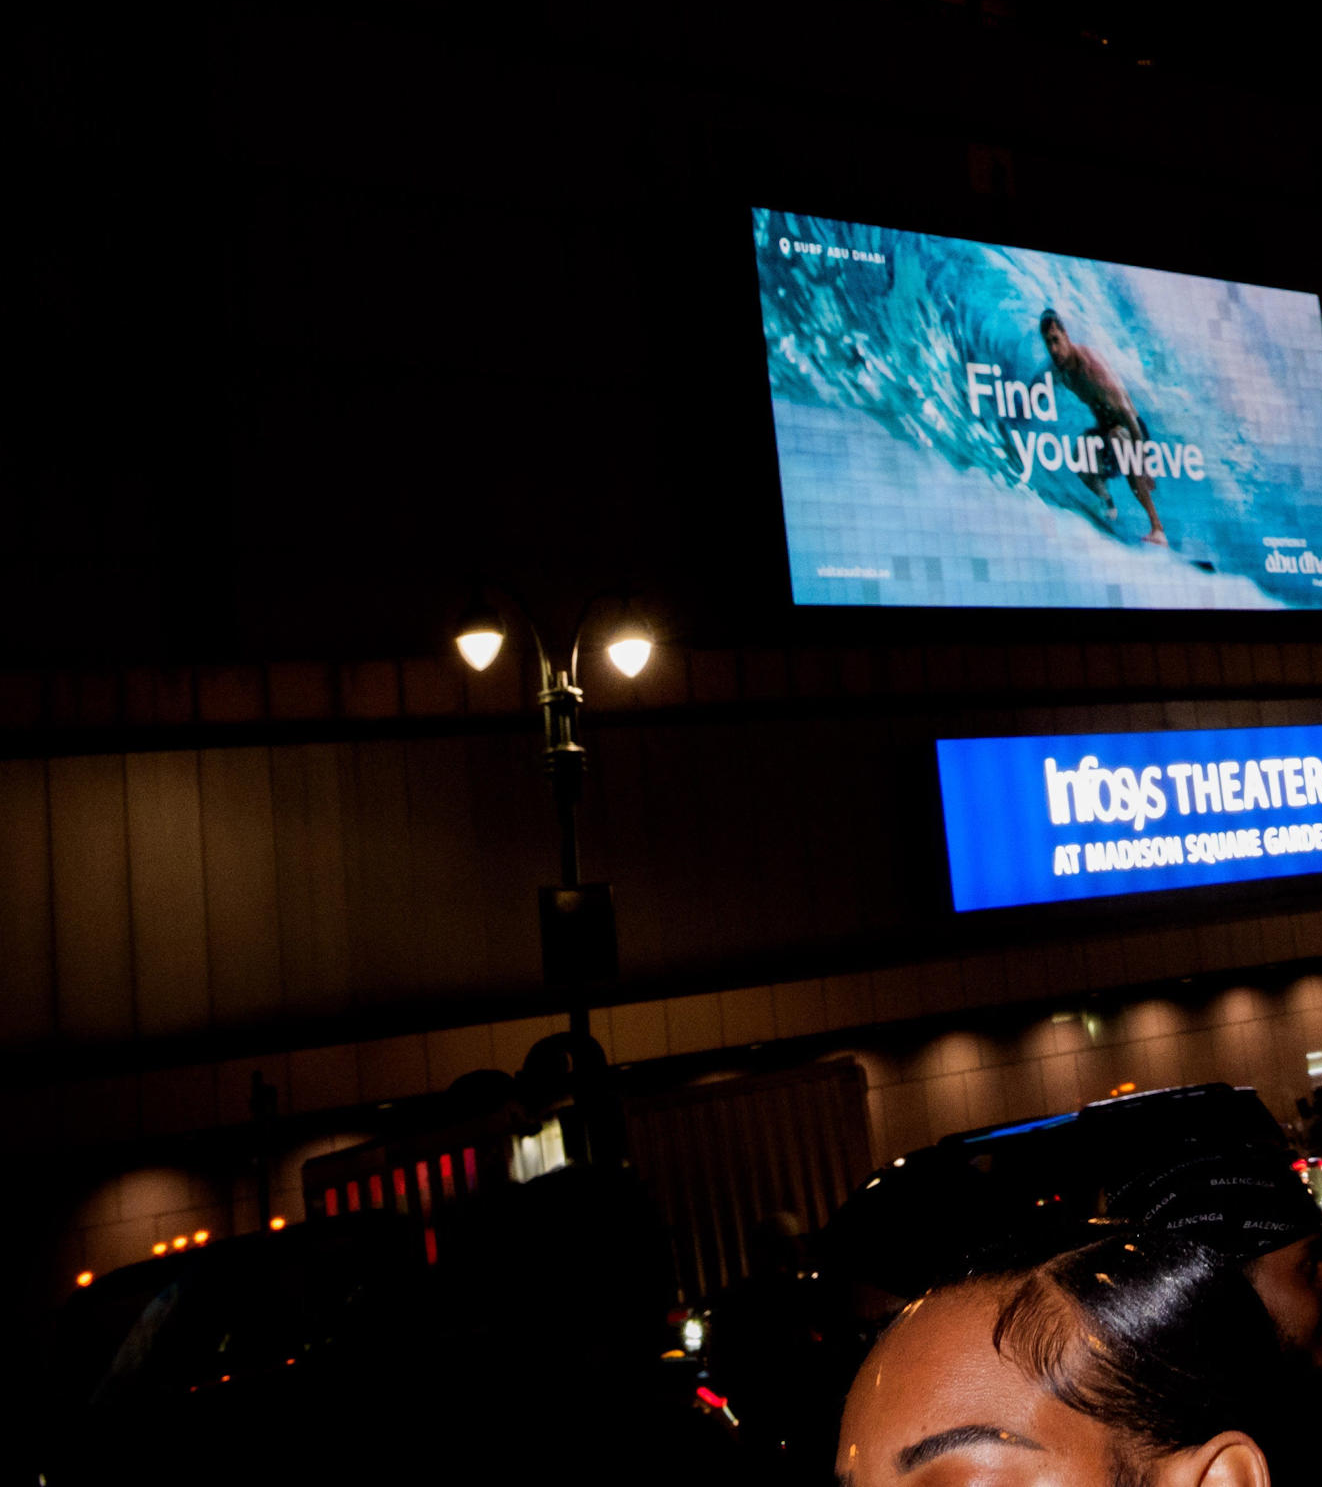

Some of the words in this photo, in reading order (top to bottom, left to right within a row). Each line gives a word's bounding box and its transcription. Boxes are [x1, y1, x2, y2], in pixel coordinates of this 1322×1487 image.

[827, 246, 849, 259] ABU
[852, 250, 886, 264] DHABI
[966, 362, 1058, 422] Find
[1011, 429, 1104, 482] your
[1110, 436, 1206, 481] wave
[1265, 550, 1298, 573] abu
[1044, 756, 1167, 831] Infosys
[1053, 844, 1081, 876] AT
[1085, 835, 1184, 873] MADISON
[1185, 827, 1262, 865] SQUARE
